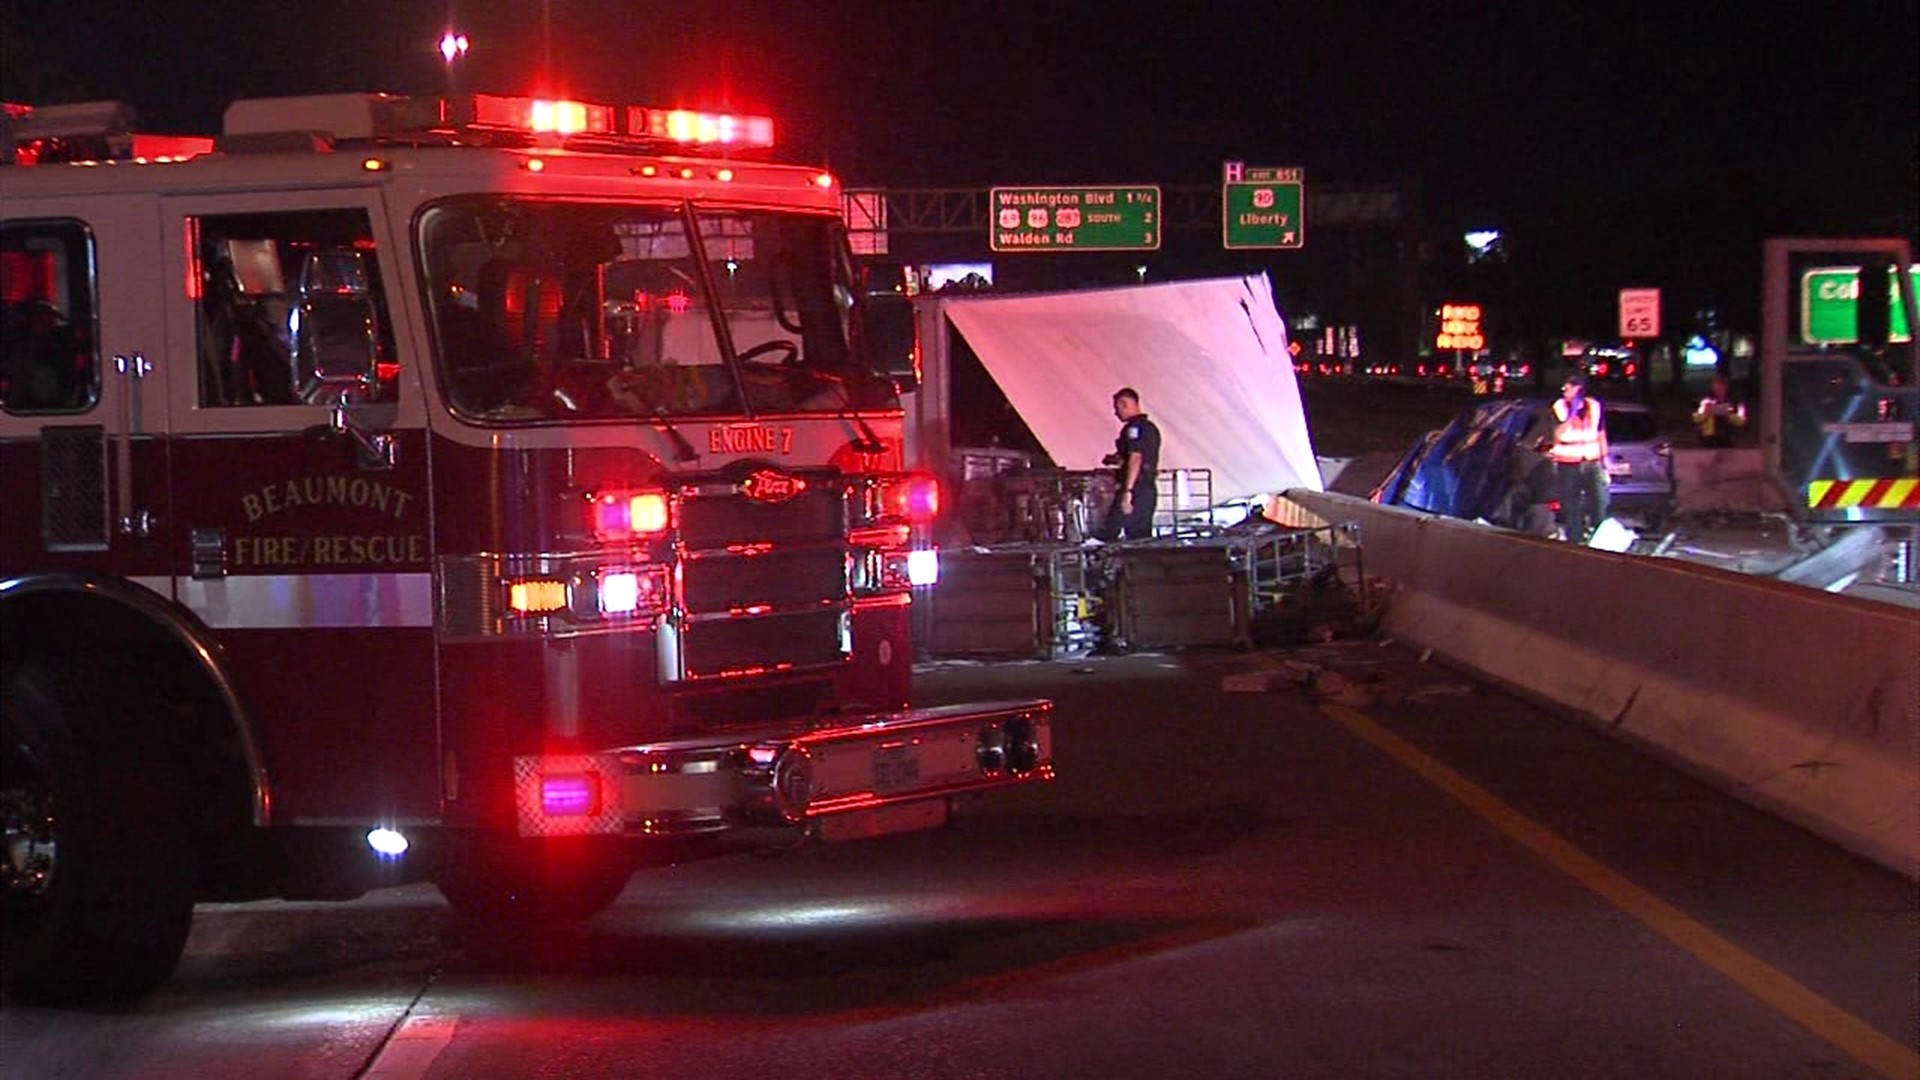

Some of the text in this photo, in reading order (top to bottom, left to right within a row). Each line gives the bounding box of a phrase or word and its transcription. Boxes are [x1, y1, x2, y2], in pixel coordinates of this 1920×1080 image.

[1225, 162, 1242, 181] H
[999, 192, 1079, 207] Washington
[1085, 192, 1115, 205] Blvd
[1087, 214, 1121, 223] SOUTH
[1144, 212, 1152, 223] 2
[1240, 213, 1288, 227] Liberty
[1000, 233, 1049, 244] Walden
[1056, 232, 1073, 243] Rd
[1626, 318, 1652, 332] 65
[710, 427, 793, 455] ENGINE 7
[240, 477, 413, 522] BEAUMONT
[235, 536, 425, 565] FIRE/RESCUE
